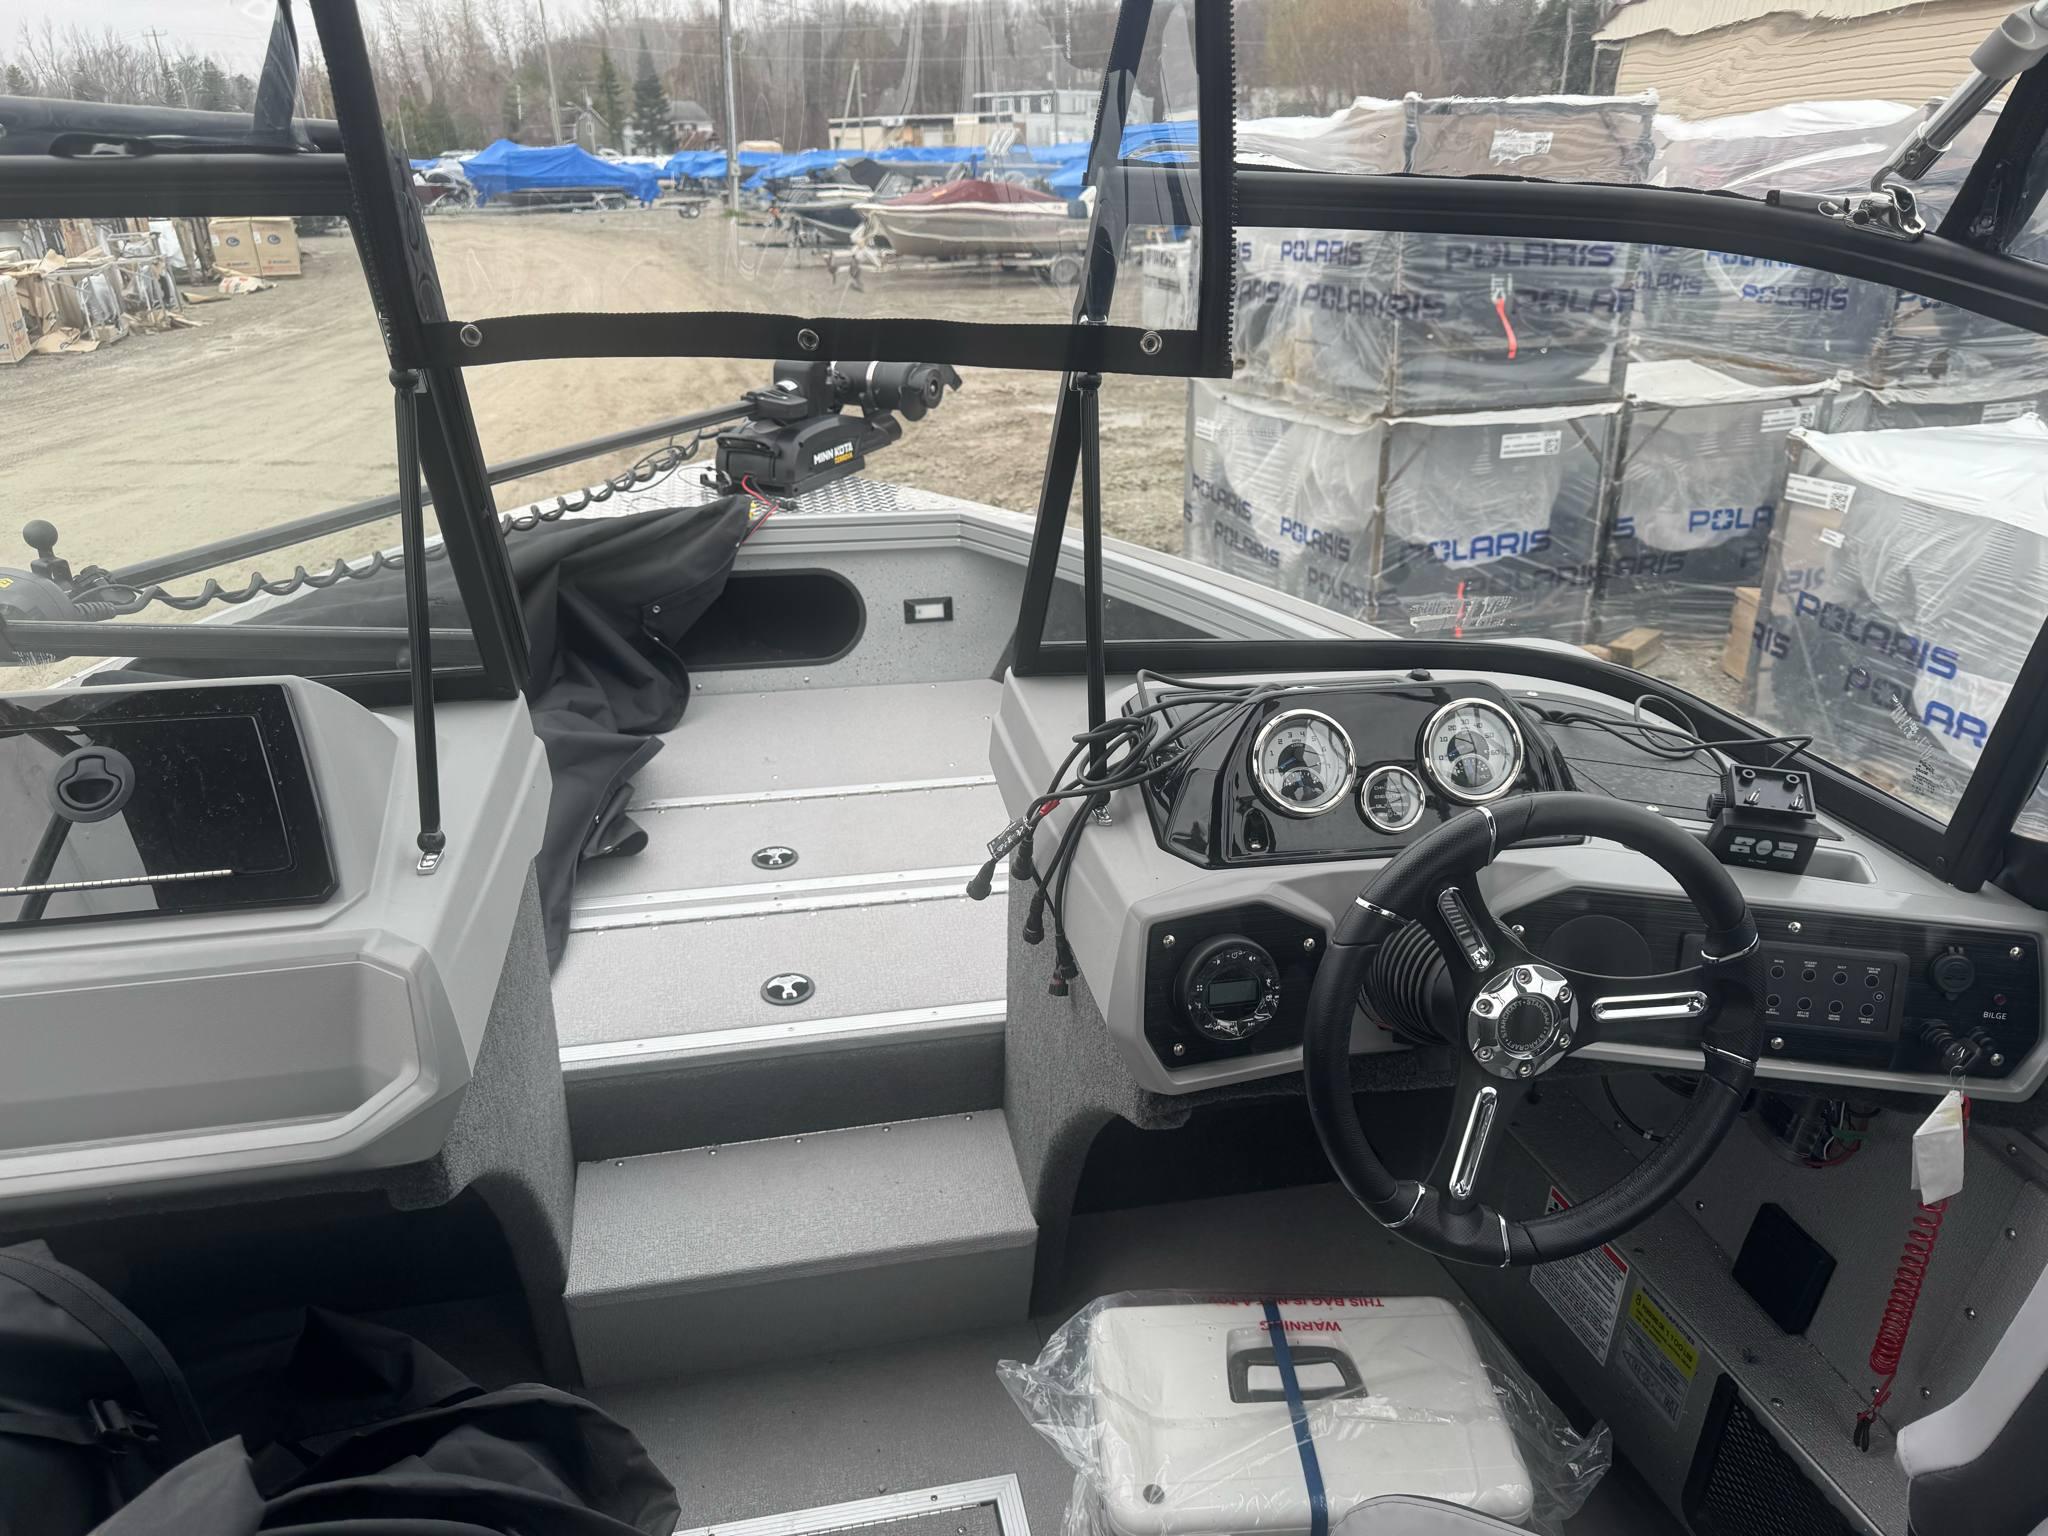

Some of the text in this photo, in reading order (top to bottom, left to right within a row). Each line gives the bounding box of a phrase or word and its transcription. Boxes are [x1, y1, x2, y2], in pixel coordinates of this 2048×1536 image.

[1280, 240, 1363, 265] POLARIS
[1447, 242, 1615, 269] POLARIS
[1743, 283, 1849, 311] POLARIS
[1192, 472, 1253, 522] POLARIS
[1213, 520, 1281, 568] POLARIS
[1280, 515, 1352, 563] POLARIS
[1795, 590, 1960, 680] POLARIS
[1983, 1010, 2008, 1020] BILGE
[1257, 1297, 1288, 1307] NT
[1295, 1297, 1307, 1306] IS
[1311, 1296, 1345, 1307] BAG
[1349, 1296, 1385, 1307] THIS
[1259, 1320, 1342, 1332] WARNIG
